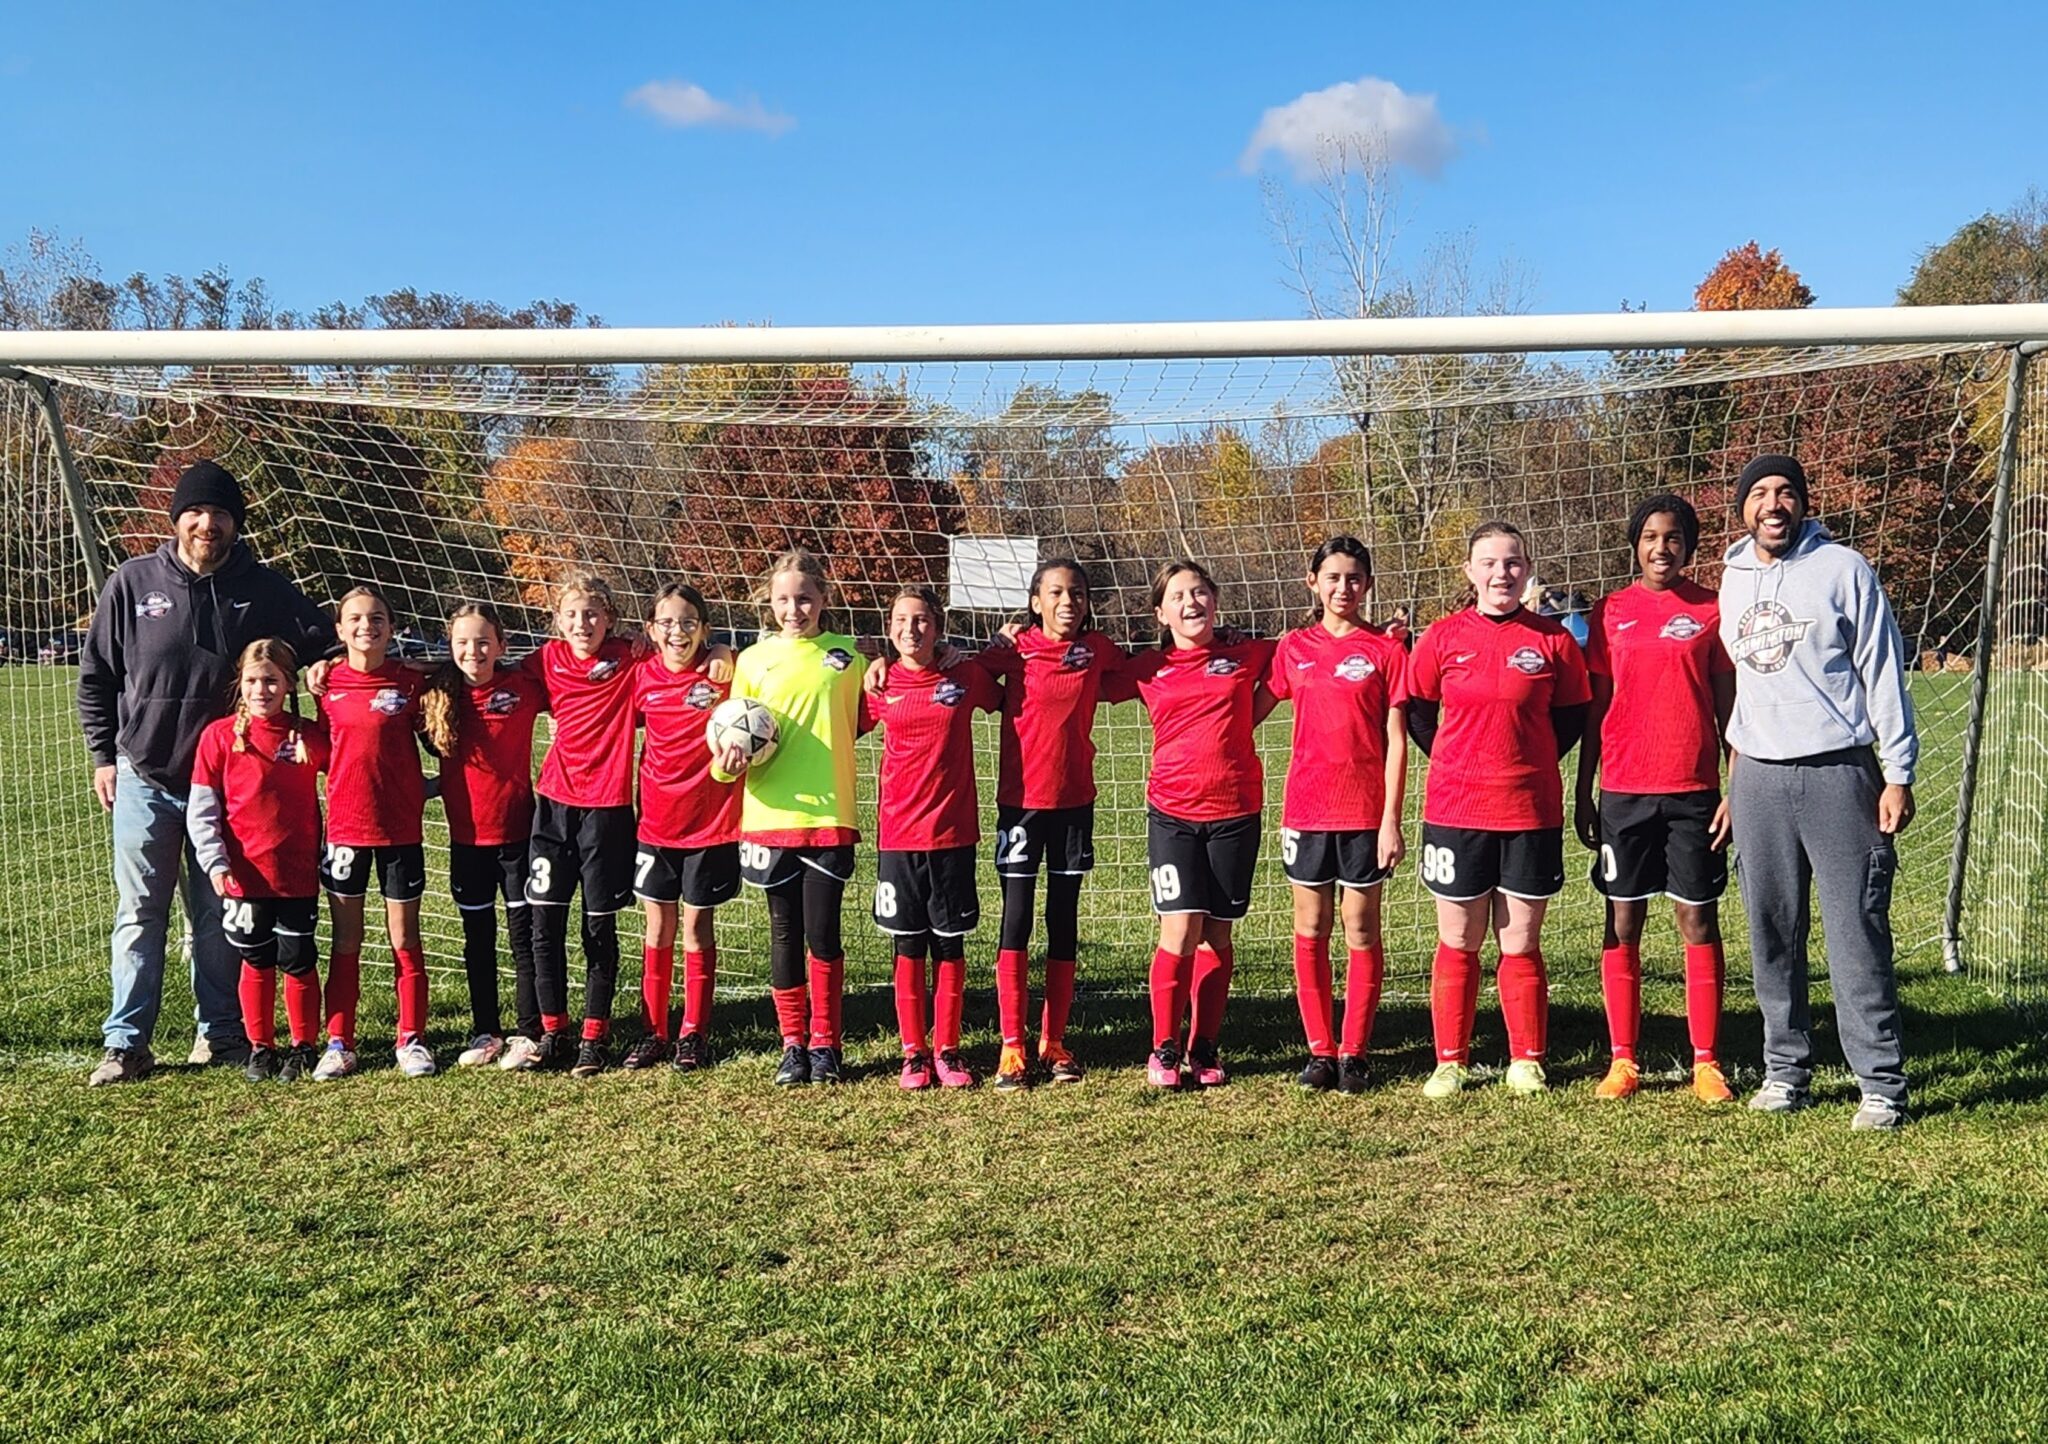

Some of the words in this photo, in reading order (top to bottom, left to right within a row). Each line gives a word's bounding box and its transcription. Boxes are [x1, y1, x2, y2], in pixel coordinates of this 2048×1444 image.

[996, 826, 1028, 865] 22
[1281, 827, 1301, 865] 5
[1423, 843, 1455, 884] 98
[531, 856, 551, 894] 3
[635, 851, 655, 888] 7
[1152, 864, 1181, 903] 19
[222, 898, 254, 934] 24
